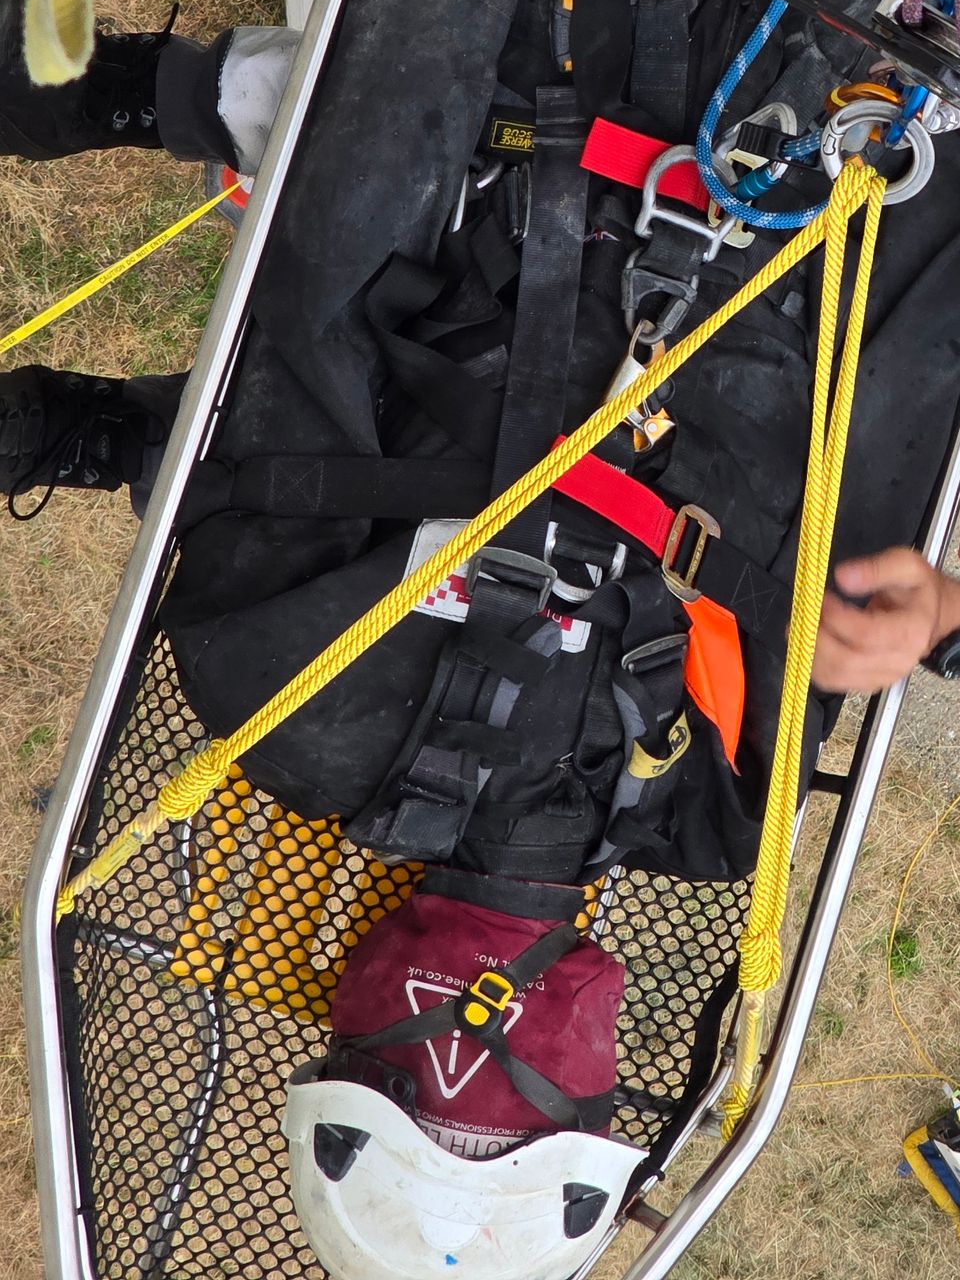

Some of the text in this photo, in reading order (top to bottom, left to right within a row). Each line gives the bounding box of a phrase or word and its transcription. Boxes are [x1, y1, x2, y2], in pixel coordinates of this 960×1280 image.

[99, 263, 126, 285] CAUTION
[136, 247, 150, 259] NOT
[150, 233, 170, 250] ENTER
[474, 952, 498, 968] No:
[422, 1110, 444, 1124] WHO
[443, 1120, 516, 1137] PROFESSIONALS
